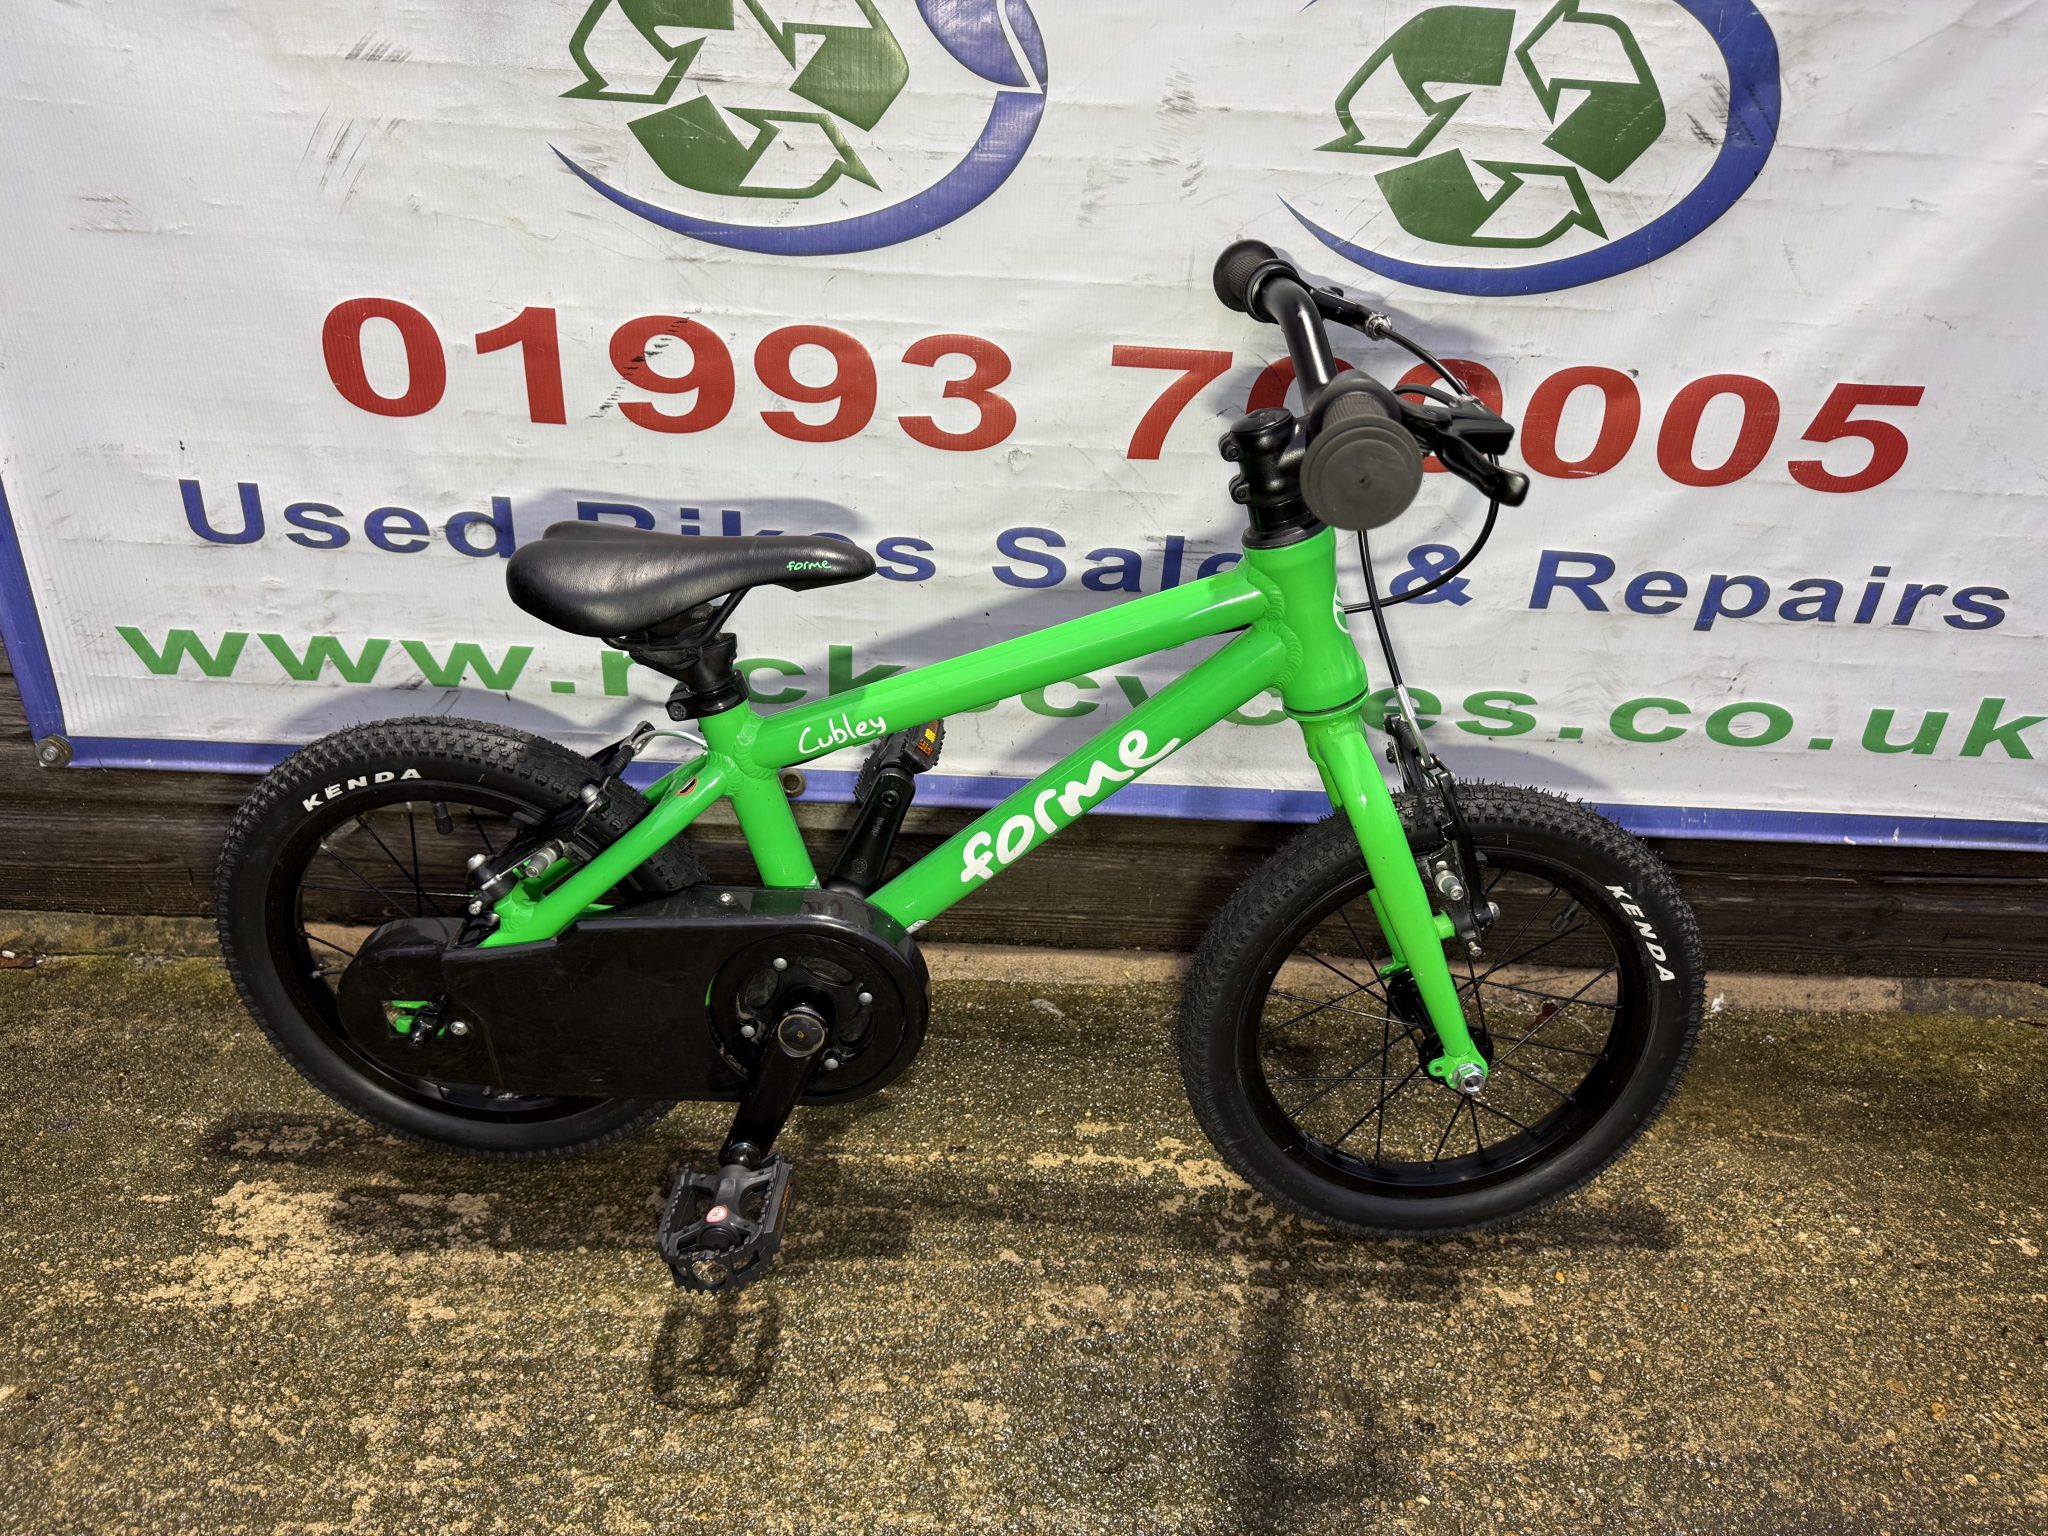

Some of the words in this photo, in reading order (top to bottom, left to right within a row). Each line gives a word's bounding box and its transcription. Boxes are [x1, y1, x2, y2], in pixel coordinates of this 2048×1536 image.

[321, 297, 1017, 451] 01993
[1111, 344, 1926, 493] 7005
[178, 479, 516, 559] Used
[1390, 543, 1474, 606] &
[1527, 549, 2011, 632] Repairs
[787, 560, 832, 571] forme
[799, 713, 887, 753] Cubley
[302, 768, 422, 812] KENDA
[960, 730, 1181, 882] forme
[1604, 885, 1676, 981] KENDA
